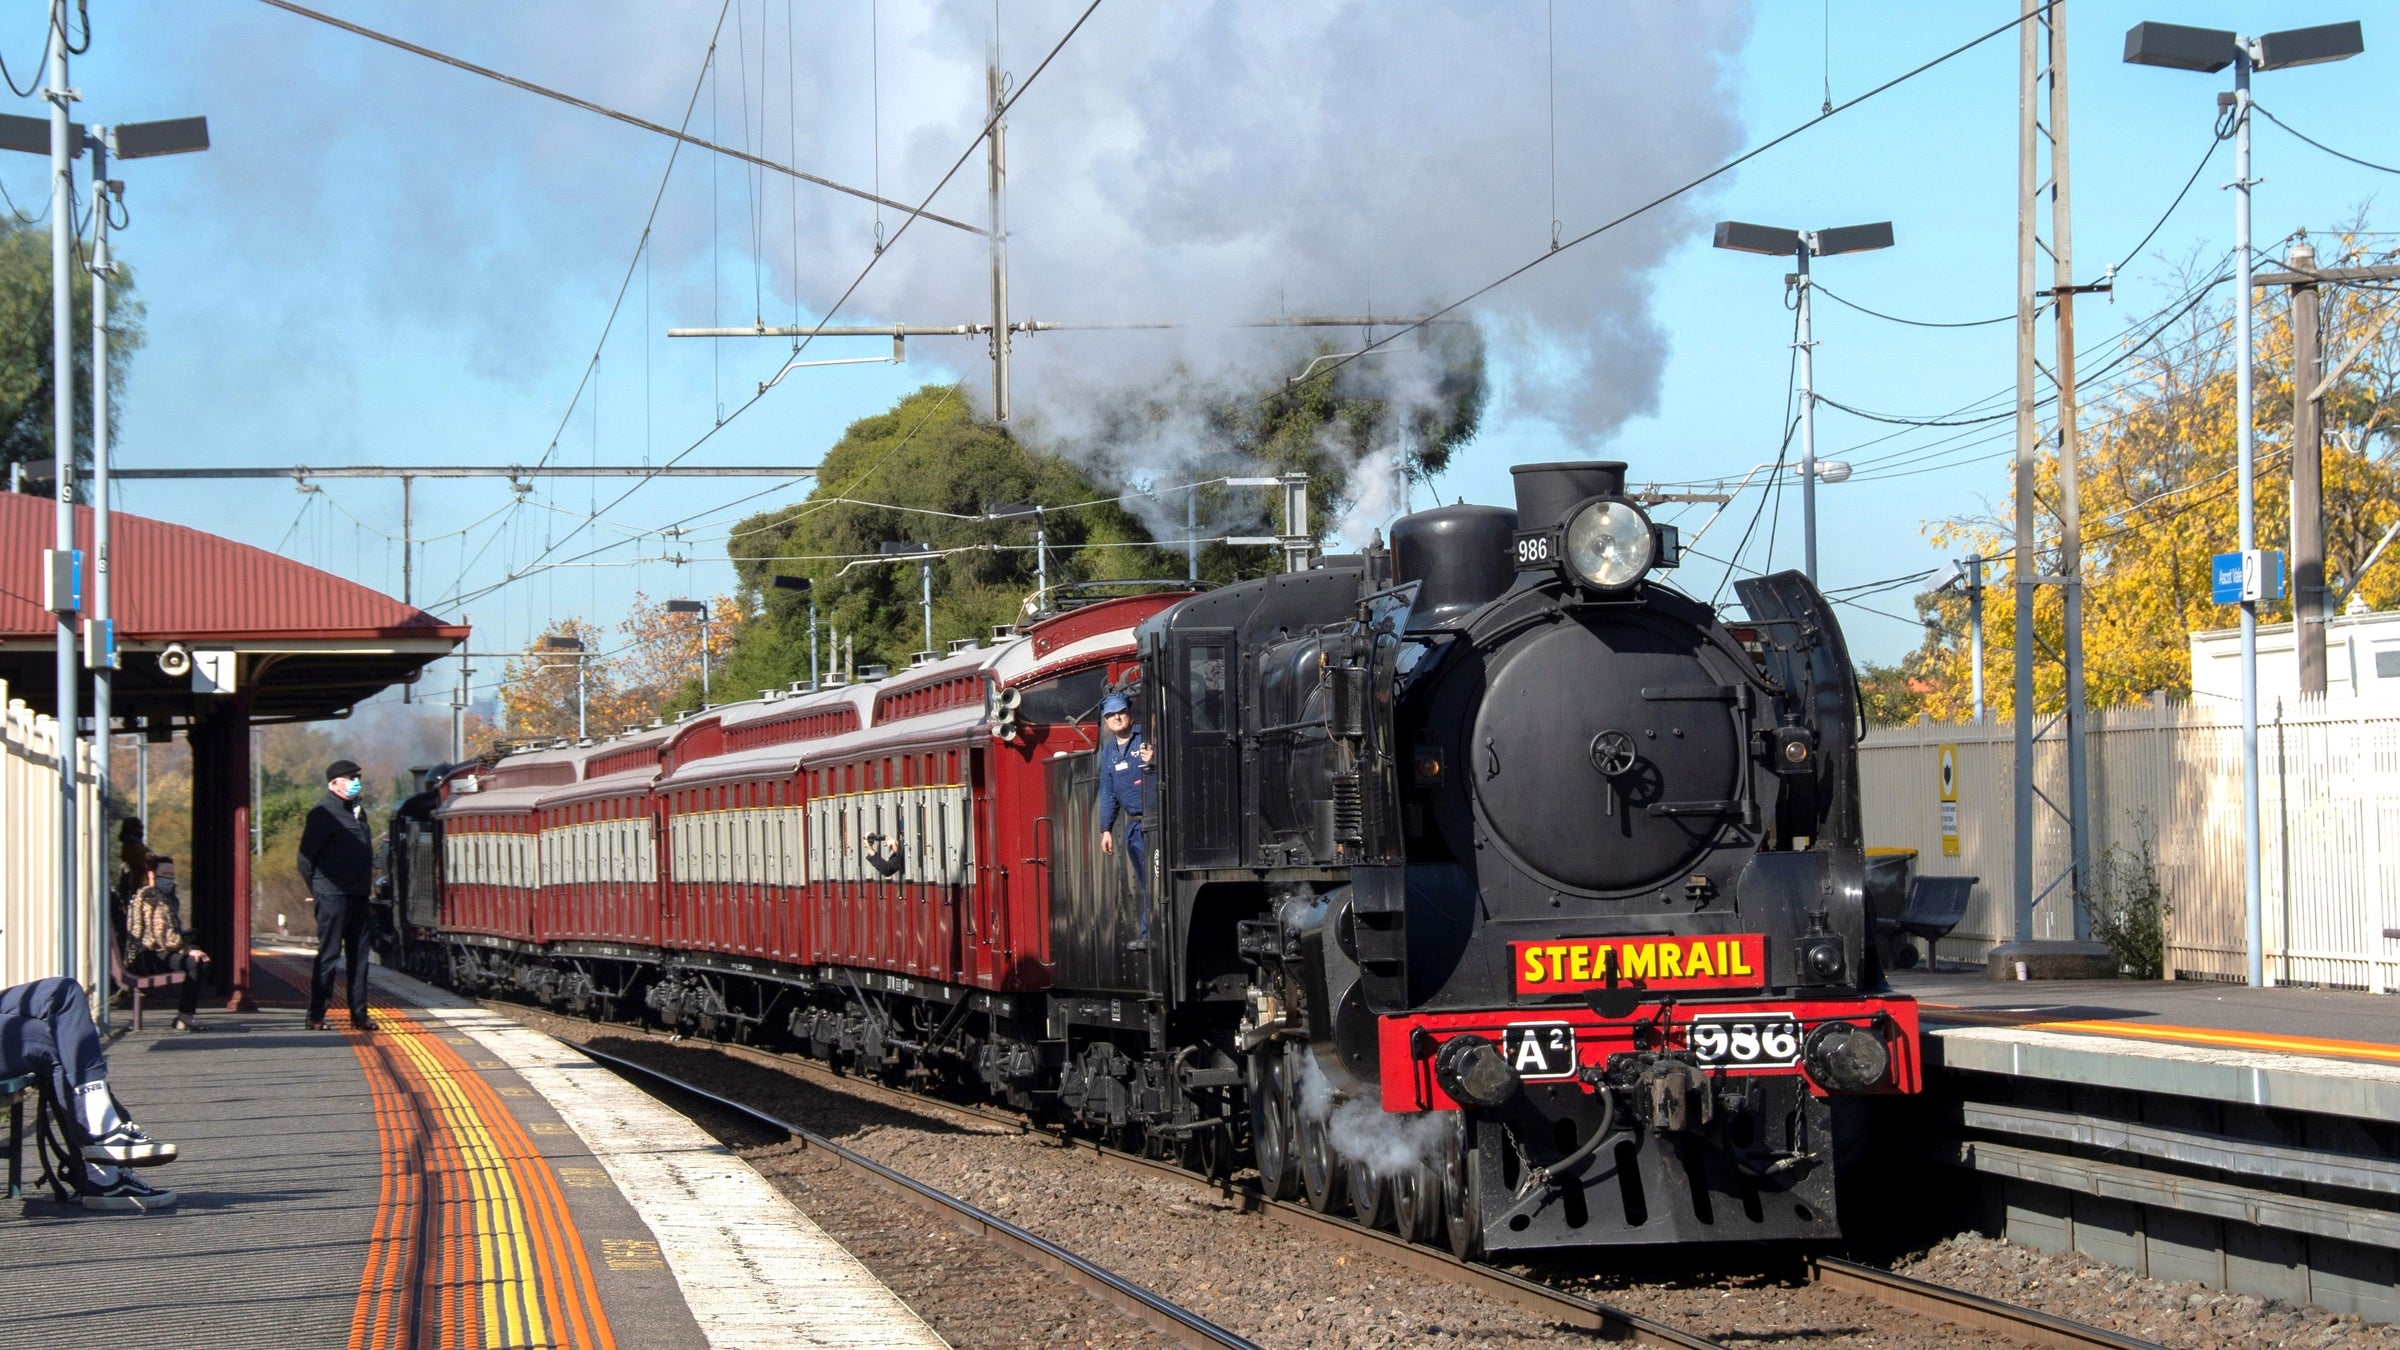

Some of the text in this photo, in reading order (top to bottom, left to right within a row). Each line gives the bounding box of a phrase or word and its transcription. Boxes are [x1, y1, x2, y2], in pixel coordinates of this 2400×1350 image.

[1518, 537, 1547, 562] 986
[2246, 555, 2253, 594] 2
[206, 655, 218, 689] 1
[1525, 941, 1751, 982] STEAMRAIL
[1694, 1023, 1796, 1060] 986
